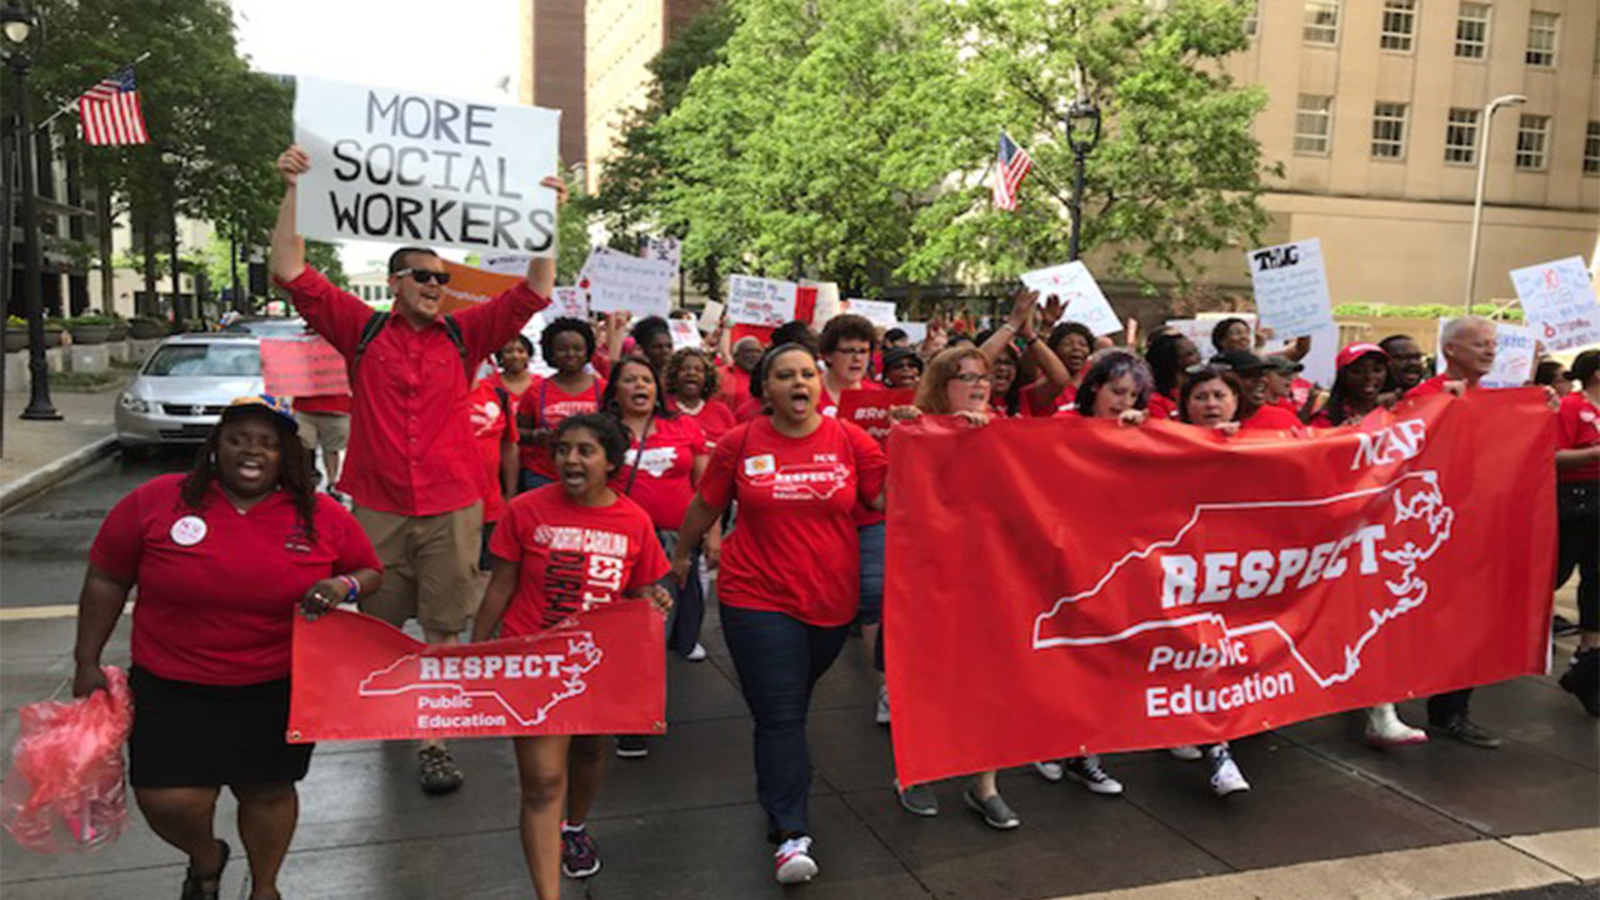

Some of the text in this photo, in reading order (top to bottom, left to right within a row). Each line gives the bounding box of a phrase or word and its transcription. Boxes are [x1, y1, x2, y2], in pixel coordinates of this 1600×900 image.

[366, 90, 497, 147] MORE
[332, 138, 523, 200] SOCIAL
[329, 190, 555, 252] WORKERS
[1159, 524, 1386, 609] RESPECT
[419, 654, 565, 681] RESPECT
[1147, 638, 1249, 673] Public
[417, 695, 473, 709] Public
[1145, 670, 1295, 718] Education
[417, 713, 506, 729] Education
